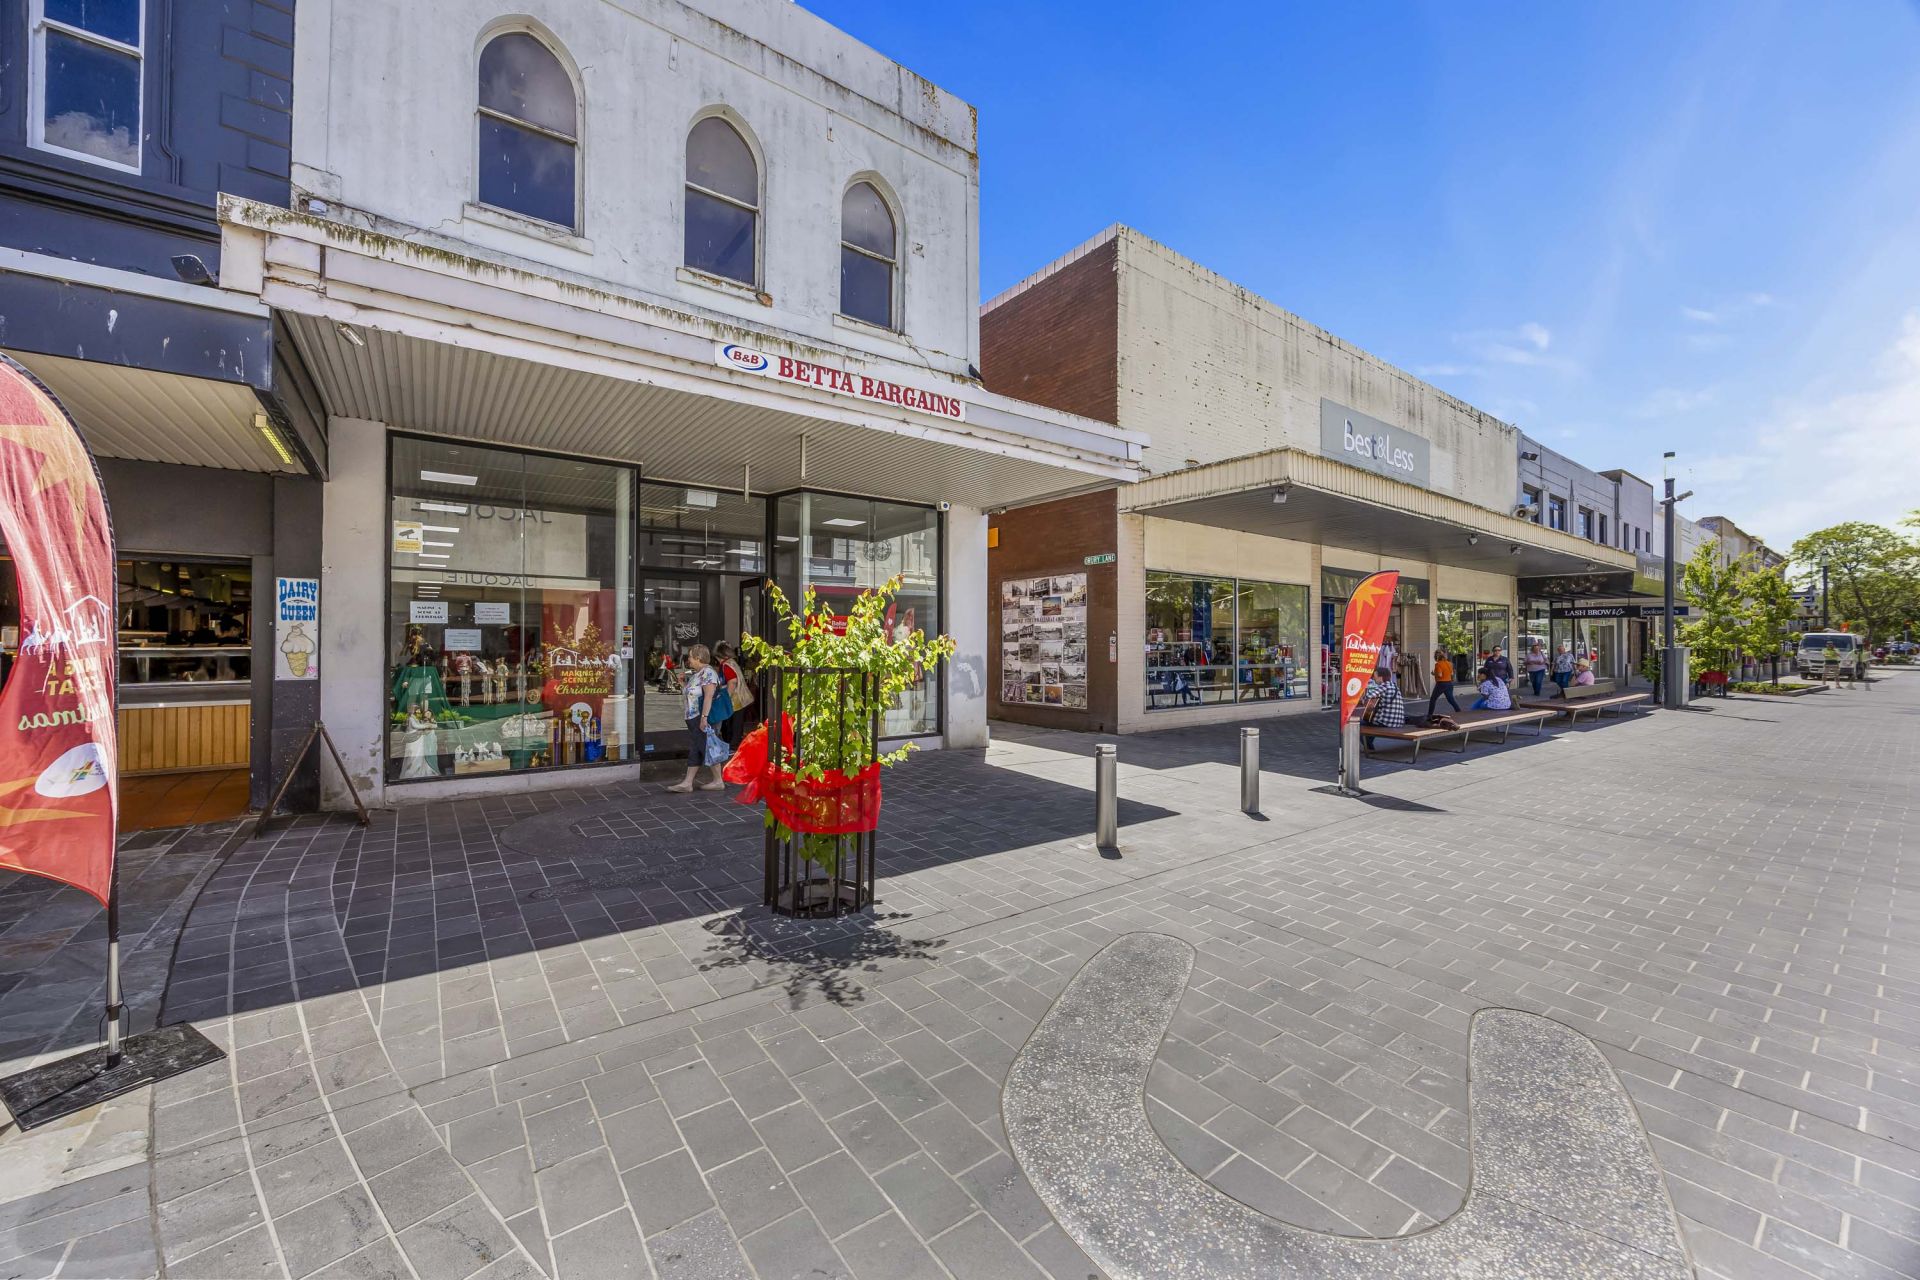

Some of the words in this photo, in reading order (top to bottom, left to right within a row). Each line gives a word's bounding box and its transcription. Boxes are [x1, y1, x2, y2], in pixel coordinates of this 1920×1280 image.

[733, 351, 760, 365] B&B
[778, 356, 855, 394] BETTA
[860, 376, 962, 418] BARGAINS
[279, 579, 317, 602] DAIRY
[280, 602, 316, 621] QUEEN
[555, 684, 608, 695] Christmas
